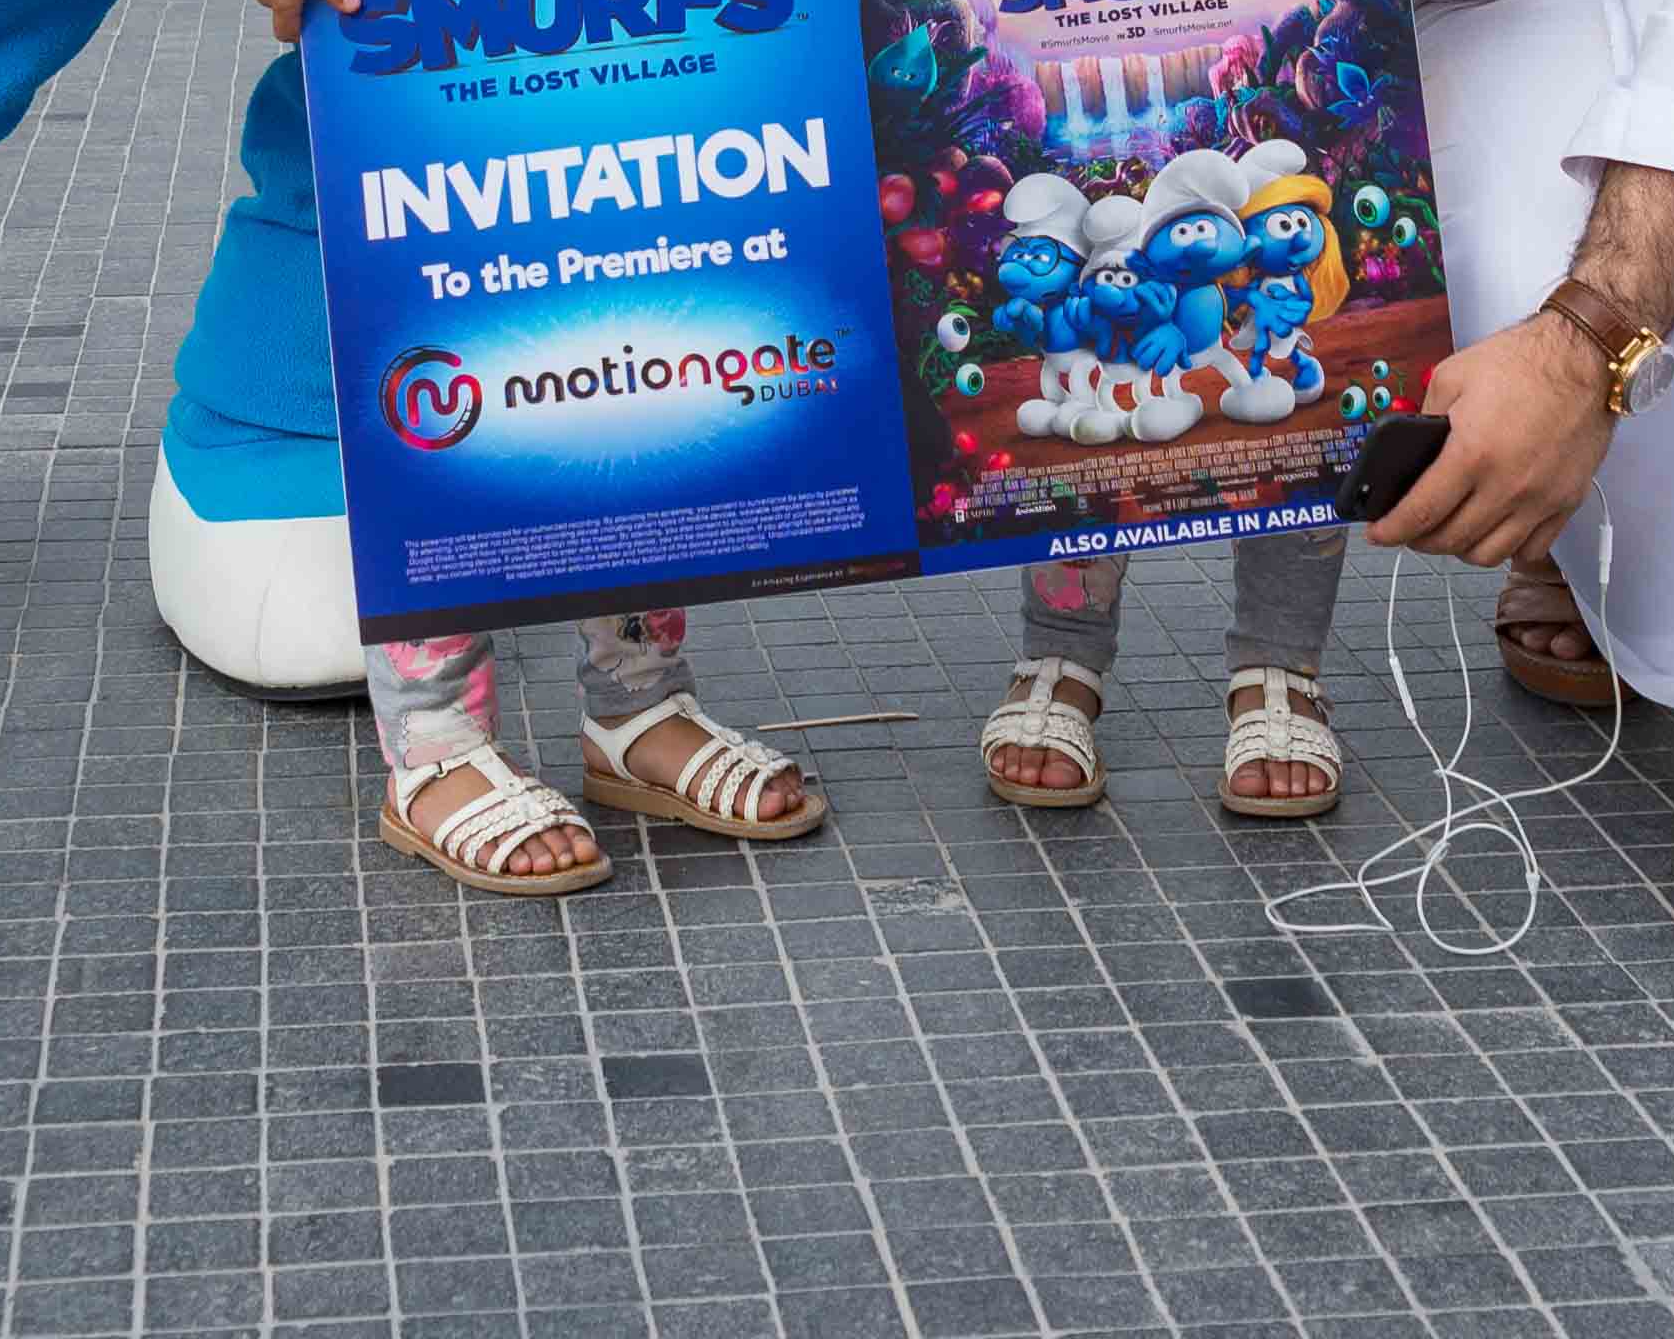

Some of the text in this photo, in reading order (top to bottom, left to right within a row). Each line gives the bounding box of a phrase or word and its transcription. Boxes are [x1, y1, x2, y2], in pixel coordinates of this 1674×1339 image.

[1055, 11, 1091, 28] THE
[1098, 5, 1143, 24] LOST
[1127, 26, 1146, 39] 3D
[439, 52, 718, 103] THE LOST VILLAGE
[360, 117, 831, 242] INVITATION
[422, 227, 788, 300] To the Premiere at
[504, 333, 837, 409] motiongate
[760, 378, 840, 402] DUBAI
[1049, 503, 1340, 556] ALSO AVAILABLE IN ARABI
